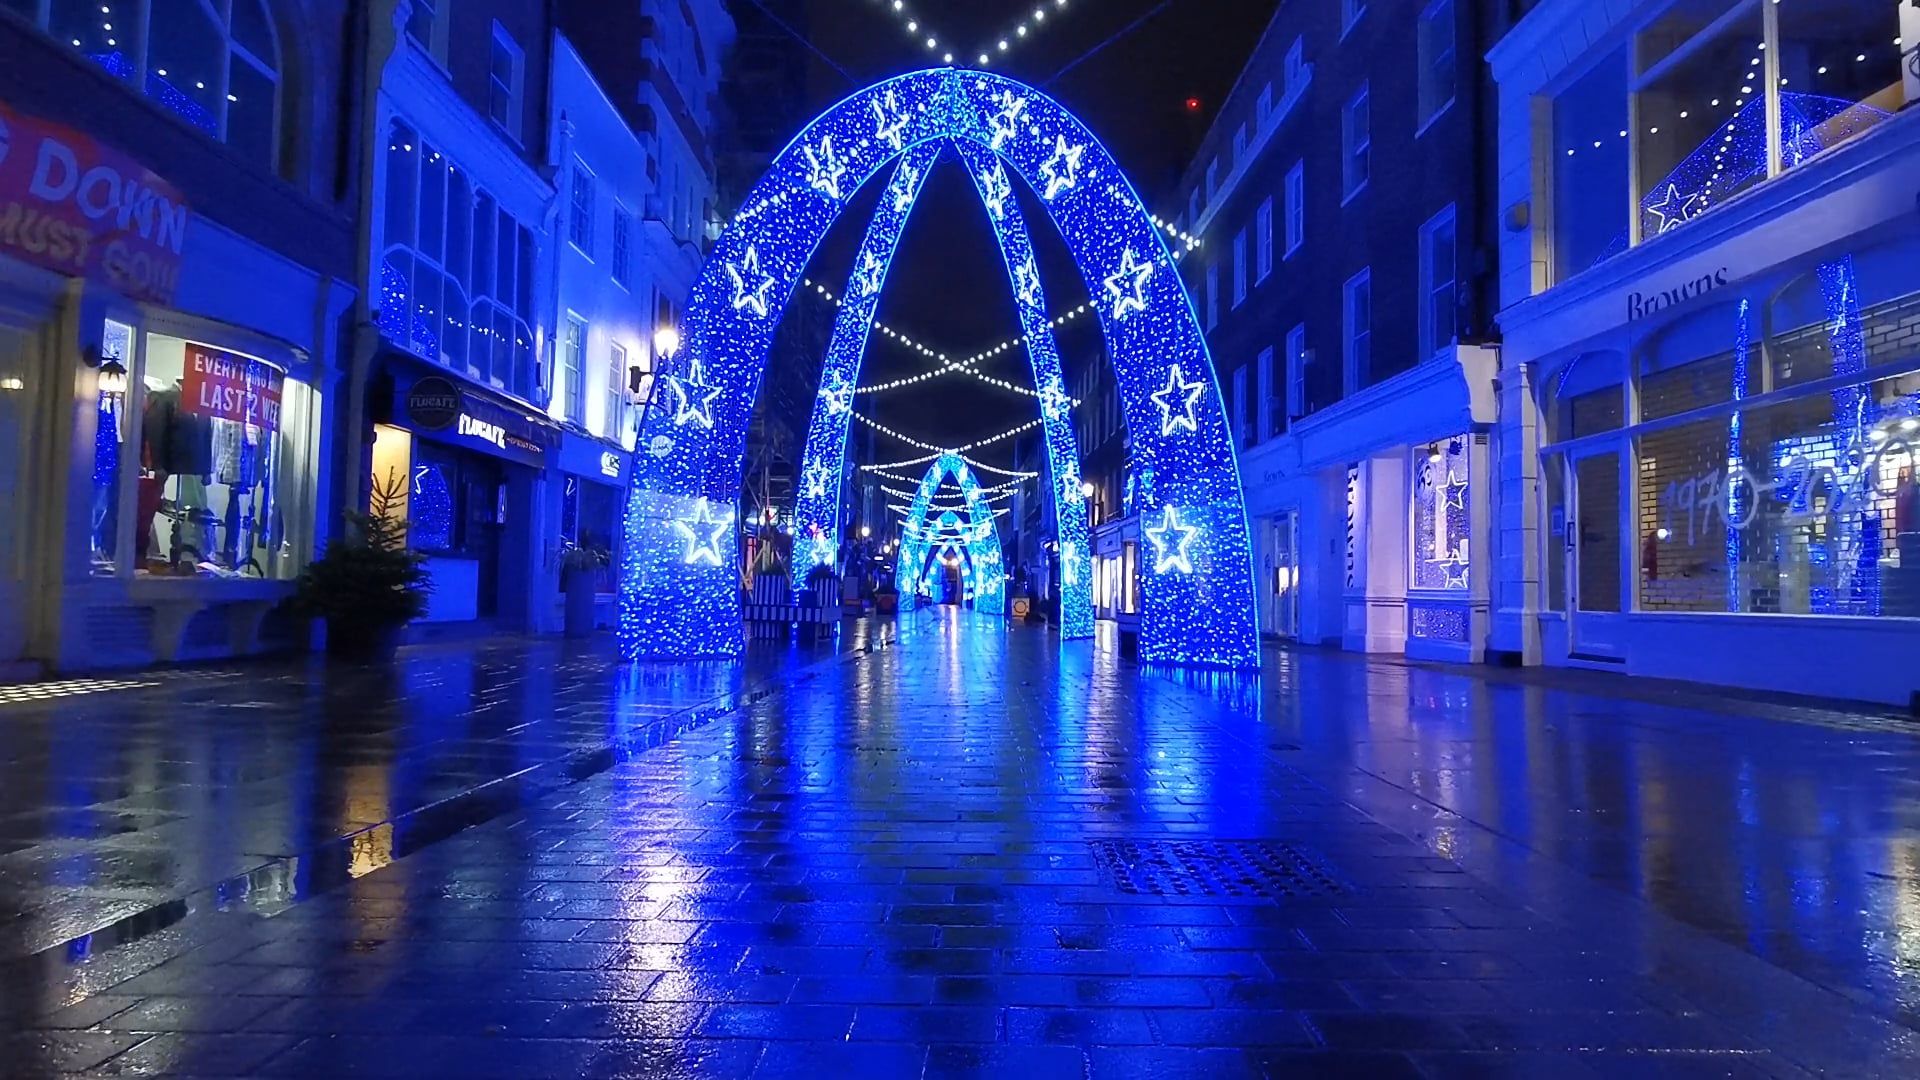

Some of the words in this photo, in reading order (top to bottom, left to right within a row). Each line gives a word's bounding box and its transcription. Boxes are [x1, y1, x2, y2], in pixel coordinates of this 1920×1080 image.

[29, 137, 186, 255] DOWN
[1627, 266, 1728, 321] Browns
[200, 381, 246, 414] LAST
[249, 393, 259, 418] 2
[1659, 437, 1915, 546] 1970-2020
